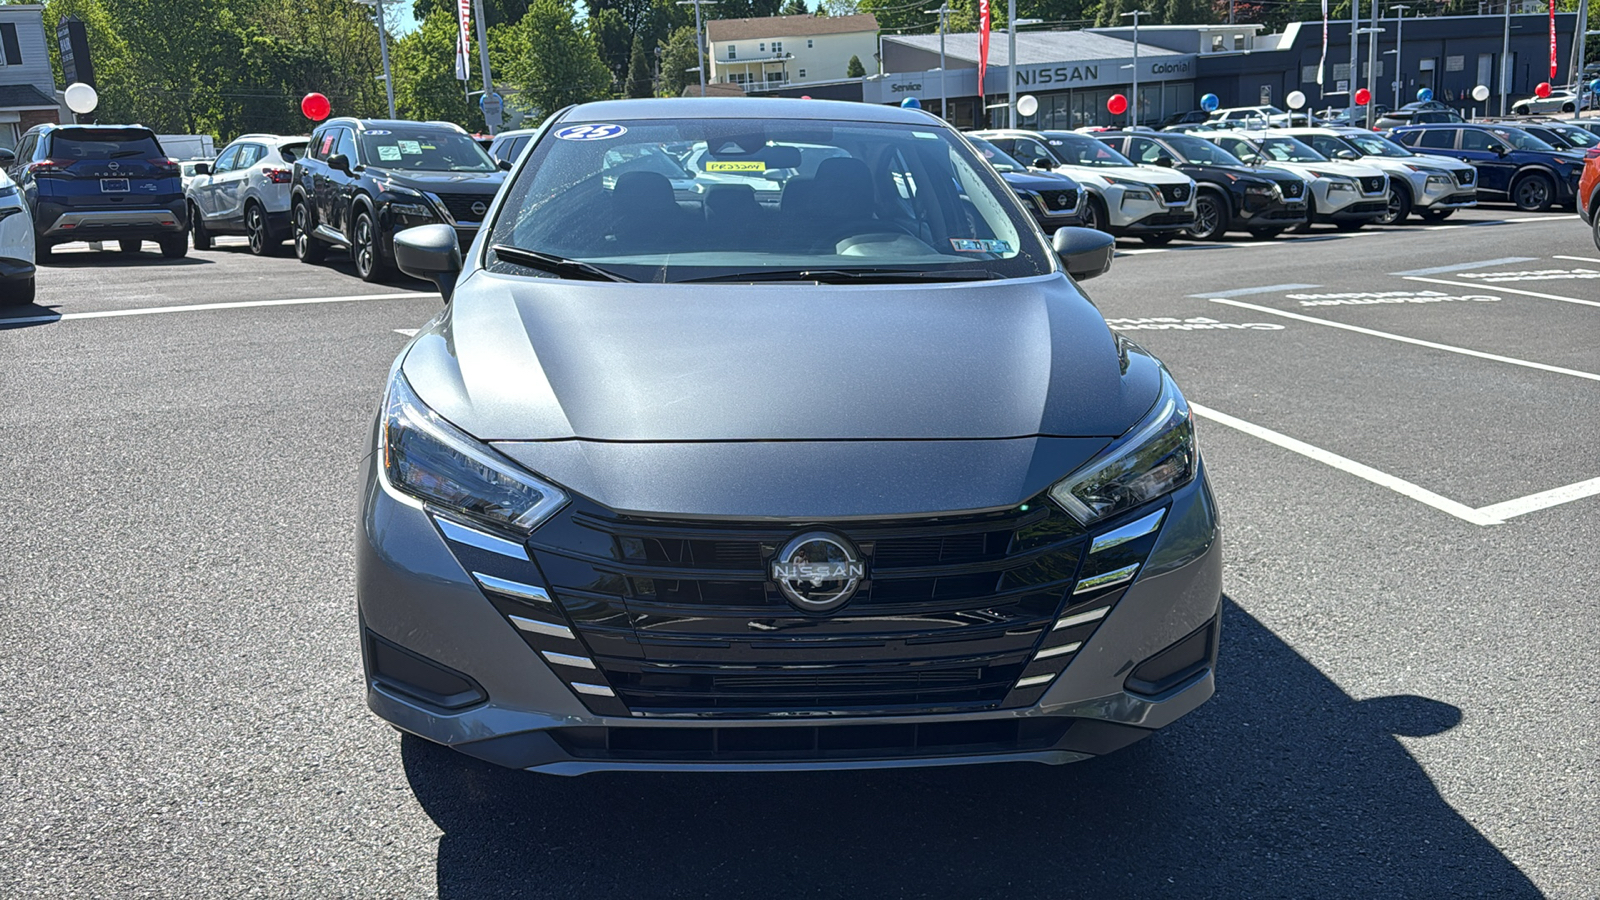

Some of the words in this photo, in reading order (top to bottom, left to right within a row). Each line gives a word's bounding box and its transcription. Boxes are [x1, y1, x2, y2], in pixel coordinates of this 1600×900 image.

[1152, 61, 1190, 74] Colonial
[1015, 65, 1098, 85] NISSAN
[891, 81, 922, 93] Service
[562, 125, 618, 139] 25
[774, 563, 863, 578] NISSAN
